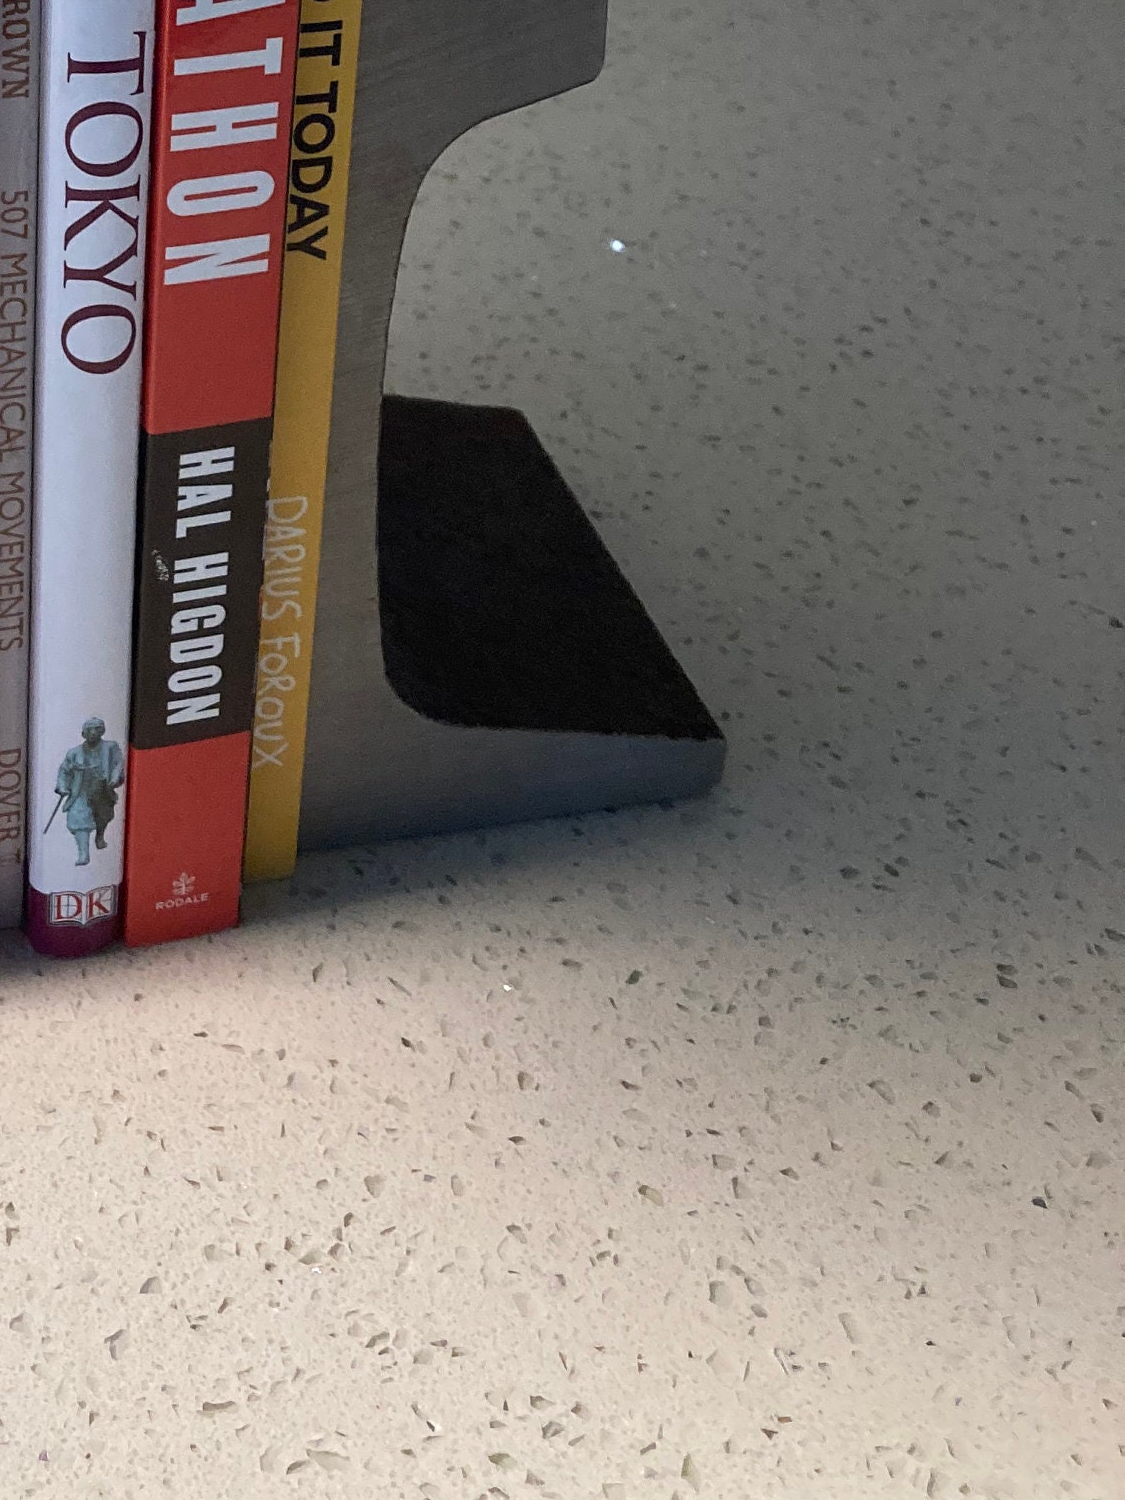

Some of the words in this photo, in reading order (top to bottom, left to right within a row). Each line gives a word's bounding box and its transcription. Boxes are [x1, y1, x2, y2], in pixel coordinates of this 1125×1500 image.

[300, 27, 343, 65] IT
[0, 190, 29, 240] 507
[60, 30, 149, 375] TOKYO
[285, 77, 339, 260] TODAY
[175, 446, 235, 539] HAL
[262, 495, 308, 622] DARIUS
[166, 552, 229, 725] HIGDON
[251, 631, 300, 773] FOROUX
[55, 892, 109, 920] DK
[155, 892, 210, 910] RODALE
